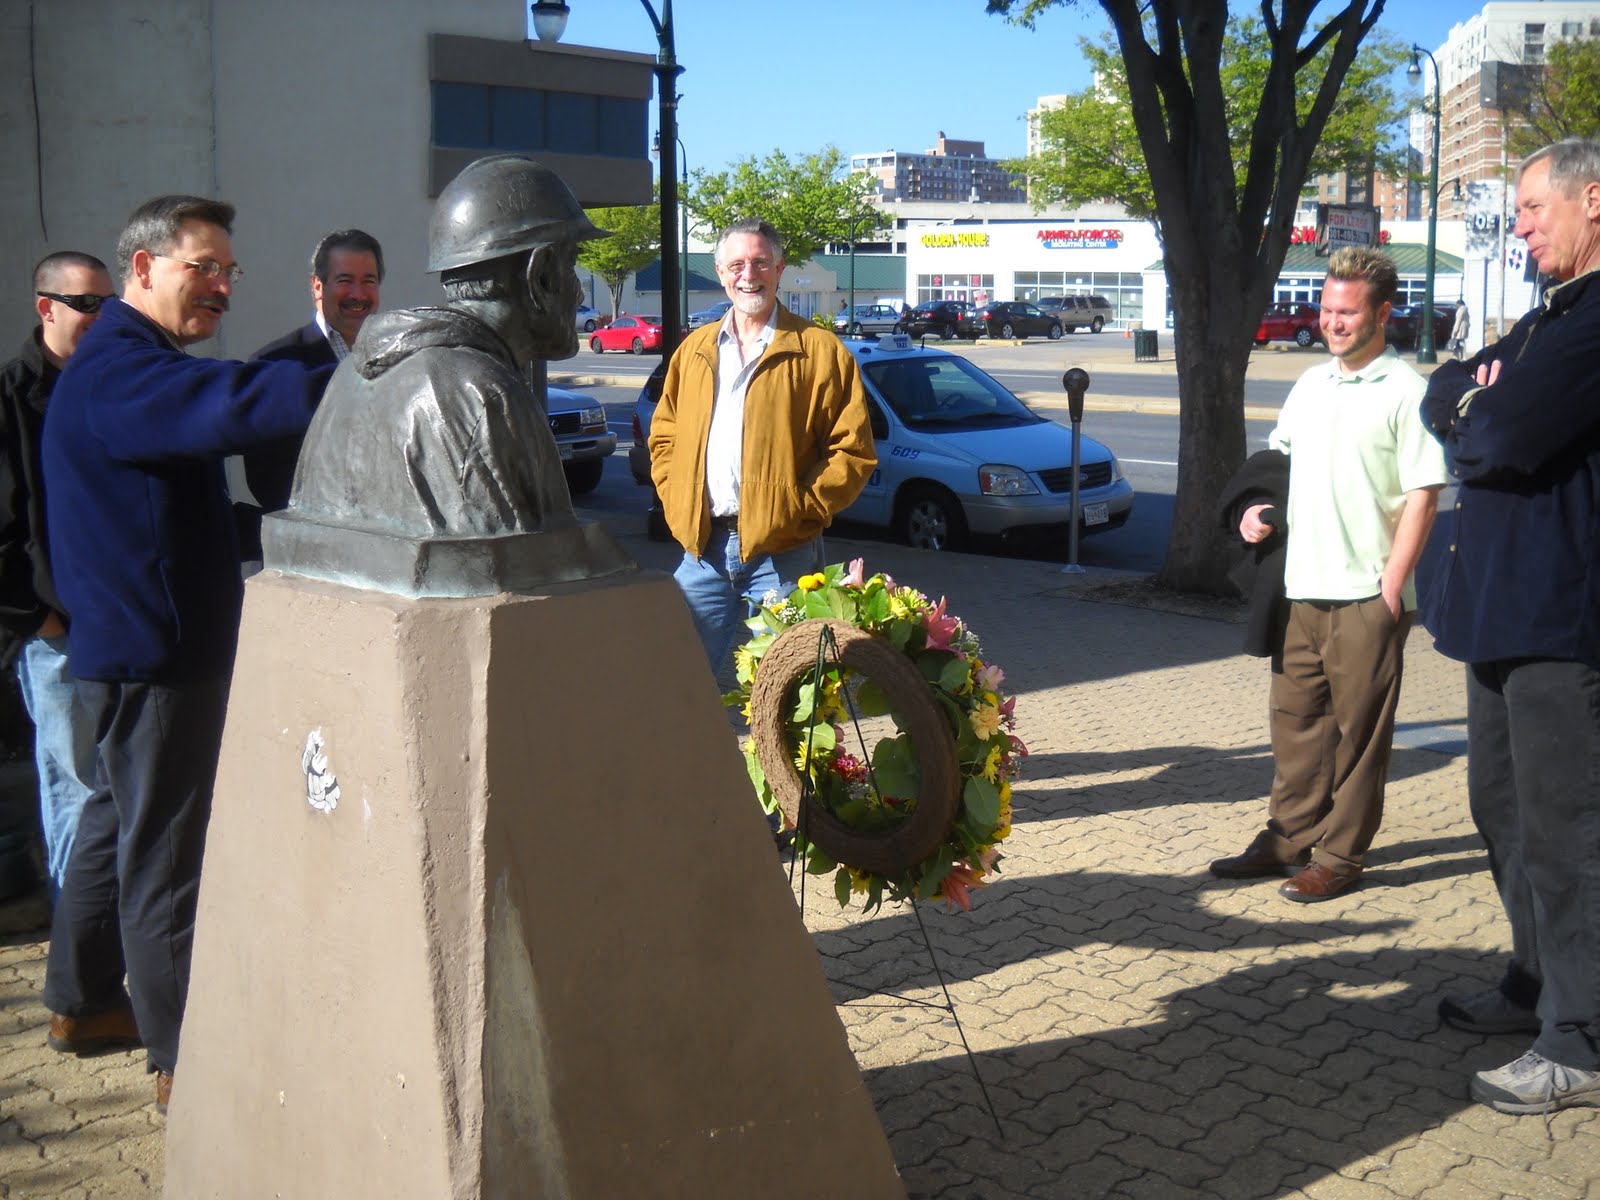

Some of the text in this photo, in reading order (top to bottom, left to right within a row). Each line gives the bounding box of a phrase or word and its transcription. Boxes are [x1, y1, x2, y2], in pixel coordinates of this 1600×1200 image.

[1329, 214, 1345, 226] FOR
[921, 232, 988, 246] GOLDEN HOUSE
[1037, 229, 1121, 240] ARMED FORCES
[891, 446, 920, 459] 609
